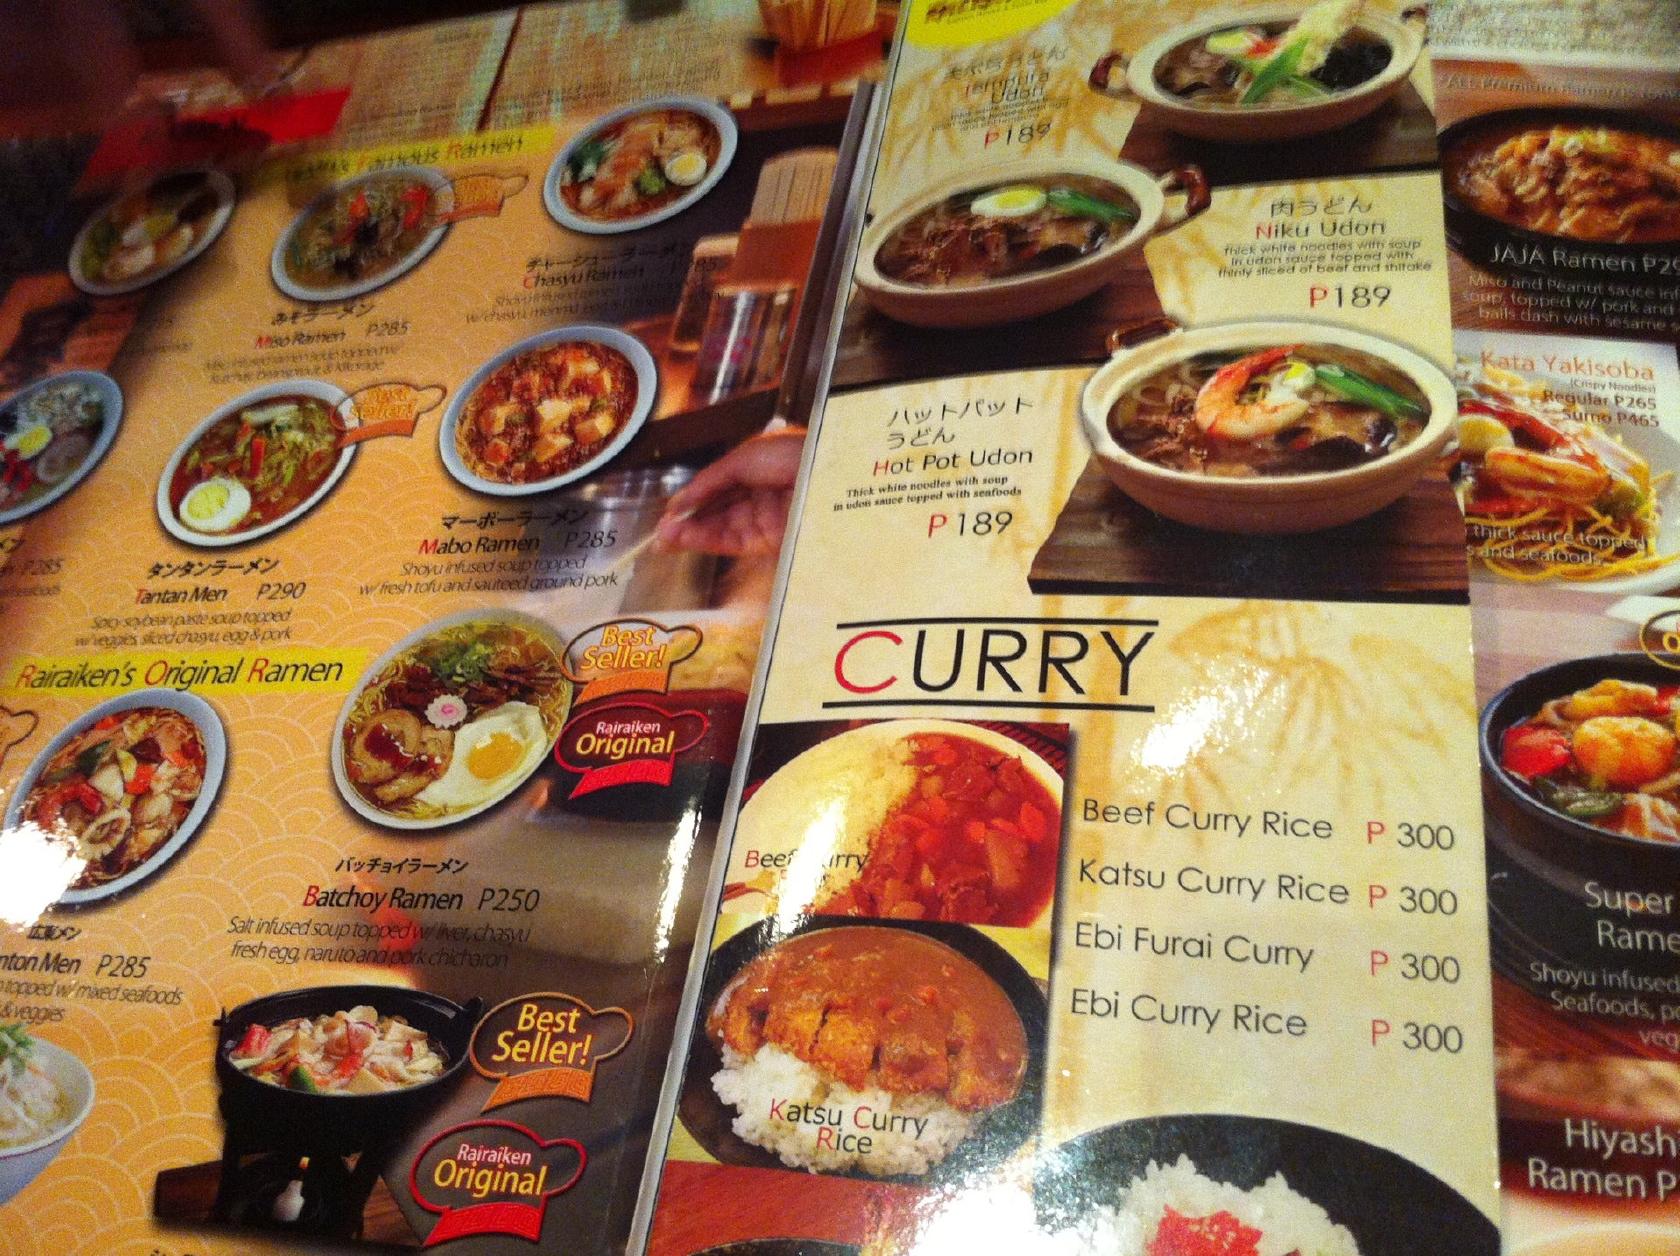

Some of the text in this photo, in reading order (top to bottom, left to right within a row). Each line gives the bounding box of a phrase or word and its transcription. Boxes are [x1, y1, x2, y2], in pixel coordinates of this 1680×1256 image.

[1270, 195, 1372, 218] 肉うどん
[1256, 220, 1386, 240] Niku Udon
[1286, 253, 1326, 265] sauce
[1331, 251, 1382, 265] topped
[1386, 250, 1415, 261] with
[1357, 239, 1386, 251] with
[1388, 240, 1422, 253] soup
[1352, 262, 1381, 273] and
[1552, 248, 1637, 274] Ramen
[1511, 277, 1543, 291] and
[1511, 291, 1571, 310] topped
[1602, 299, 1640, 315] pork
[1564, 311, 1601, 327] with
[292, 319, 410, 347] Ramen P285
[1481, 350, 1655, 381] Kata Yakisoba
[1543, 389, 1658, 410] Regular P265
[887, 426, 956, 451] うどん
[873, 448, 1034, 477] Hot Pot Udon
[833, 485, 1022, 512] in udon sauce topped with seafoods
[846, 475, 1009, 498] Thick white noodles with soup
[418, 529, 620, 556] Mabo Ramen P285
[1473, 523, 1516, 540] thick
[1522, 528, 1575, 546] sauce
[1579, 532, 1651, 553] topped
[400, 554, 589, 578] Shoyu infused soup topped
[1481, 544, 1516, 561] and
[135, 581, 307, 605] Tantan Men P290
[379, 579, 413, 596] fresh
[414, 578, 442, 594] tofu
[442, 578, 473, 593] and
[529, 573, 585, 593] ground
[584, 570, 619, 590] pork
[259, 625, 291, 643] pork
[600, 624, 657, 647] Best
[580, 643, 668, 671] Seller!
[834, 628, 1156, 696] CURRY
[16, 656, 345, 692] Rairaiken's Original Ramen
[595, 720, 662, 736] Rairaiken
[575, 730, 676, 760] Original
[1082, 798, 1456, 851] Beef Curry Rice P 300
[744, 848, 799, 869] Beef
[303, 884, 541, 914] Batchoy Ramen P250
[1078, 858, 1459, 916] Katsu Curry Rice P 300
[1583, 880, 1675, 919] Super
[226, 915, 256, 936] Salt
[255, 916, 313, 937] infused
[312, 921, 350, 941] soup
[352, 920, 414, 943] topped
[38, 952, 152, 979] Men P285
[230, 939, 267, 960] fresh
[303, 946, 354, 964] naruto
[355, 946, 391, 965] and
[1074, 921, 1462, 985] Ebi Furai Curry P 300
[1529, 961, 1597, 990] Shoyu
[78, 983, 121, 1002] mixed
[122, 986, 184, 1006] seafoods
[1550, 989, 1655, 1021] Seafoods,
[13, 1003, 66, 1025] veggies
[516, 1002, 582, 1035] Best
[1070, 986, 1464, 1054] Ebi Curry Rice P 300
[491, 1030, 594, 1066] Seller!
[768, 1098, 930, 1140] Katsu Curry
[815, 1126, 874, 1156] Rice
[456, 1143, 532, 1167] Rairaiken
[433, 1158, 550, 1199] Original
[1527, 1157, 1647, 1200] Ramen
